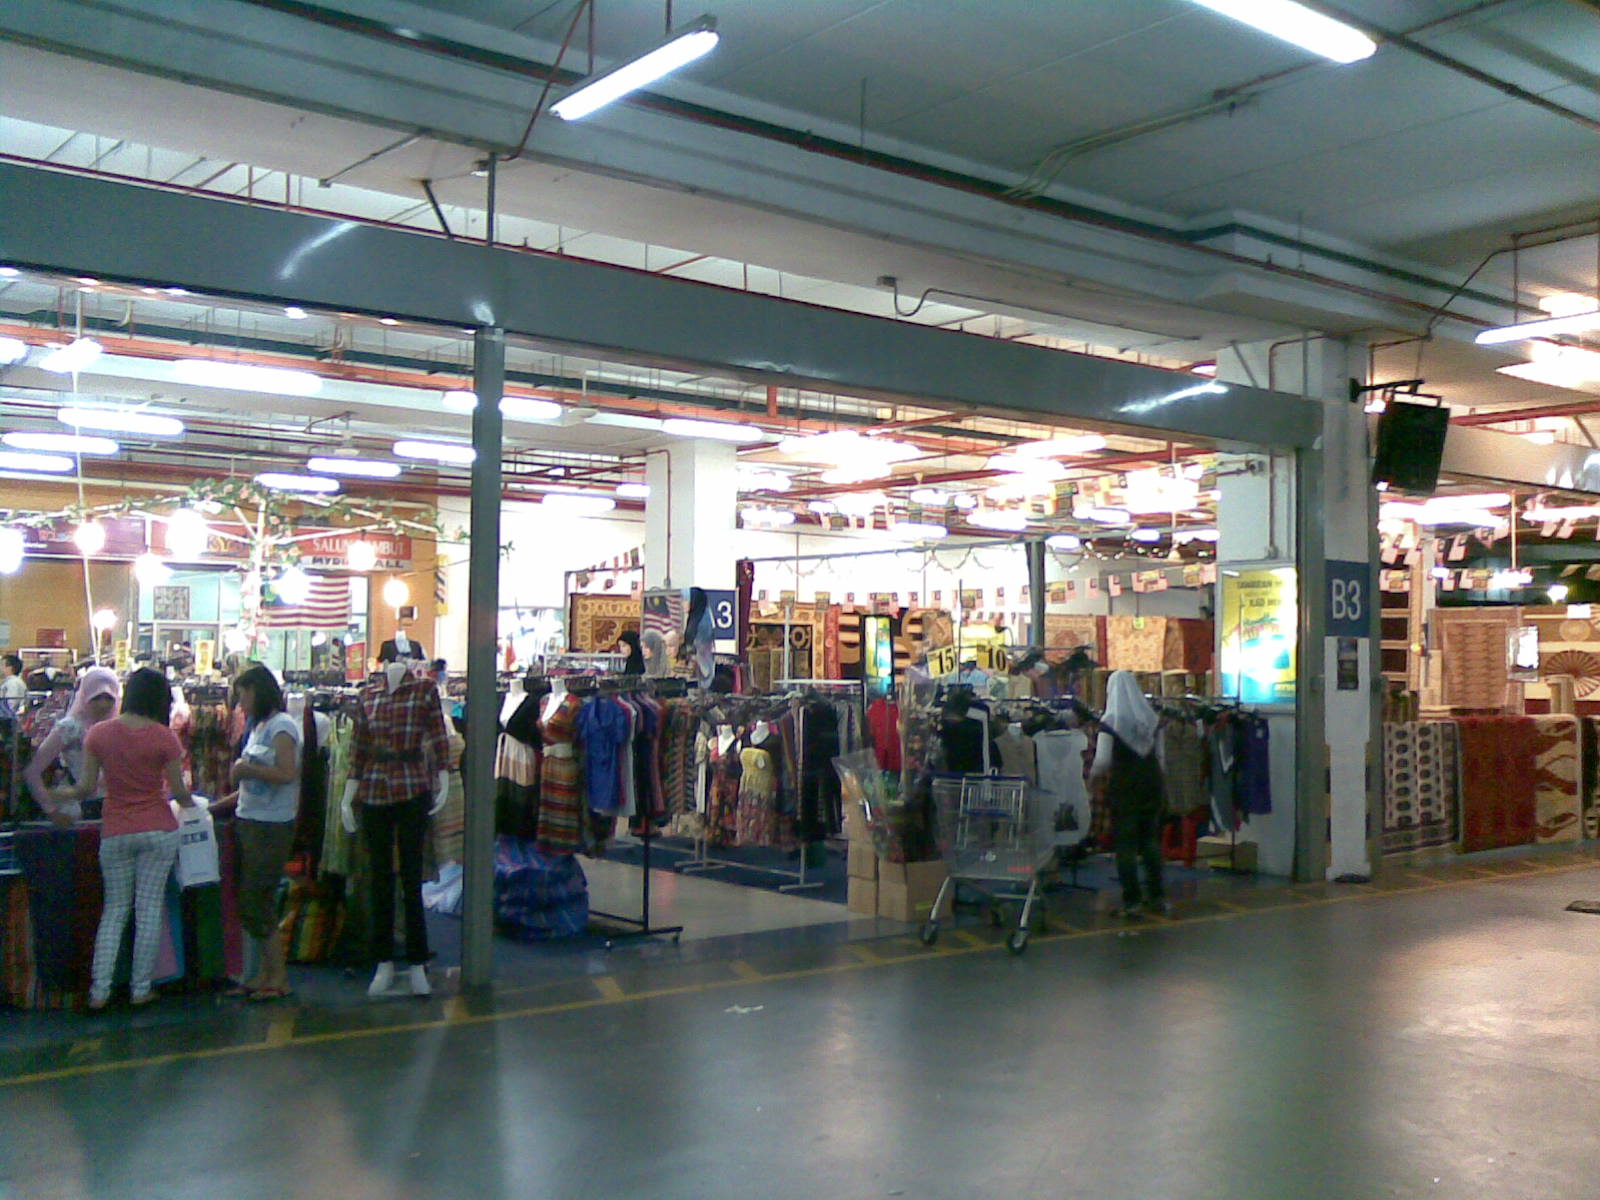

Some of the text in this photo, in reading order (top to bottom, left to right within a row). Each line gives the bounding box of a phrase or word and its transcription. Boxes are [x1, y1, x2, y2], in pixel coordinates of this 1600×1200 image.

[1331, 578, 1362, 621] B3
[708, 600, 733, 629] 3
[938, 647, 954, 675] 15
[987, 647, 1006, 672] 10
